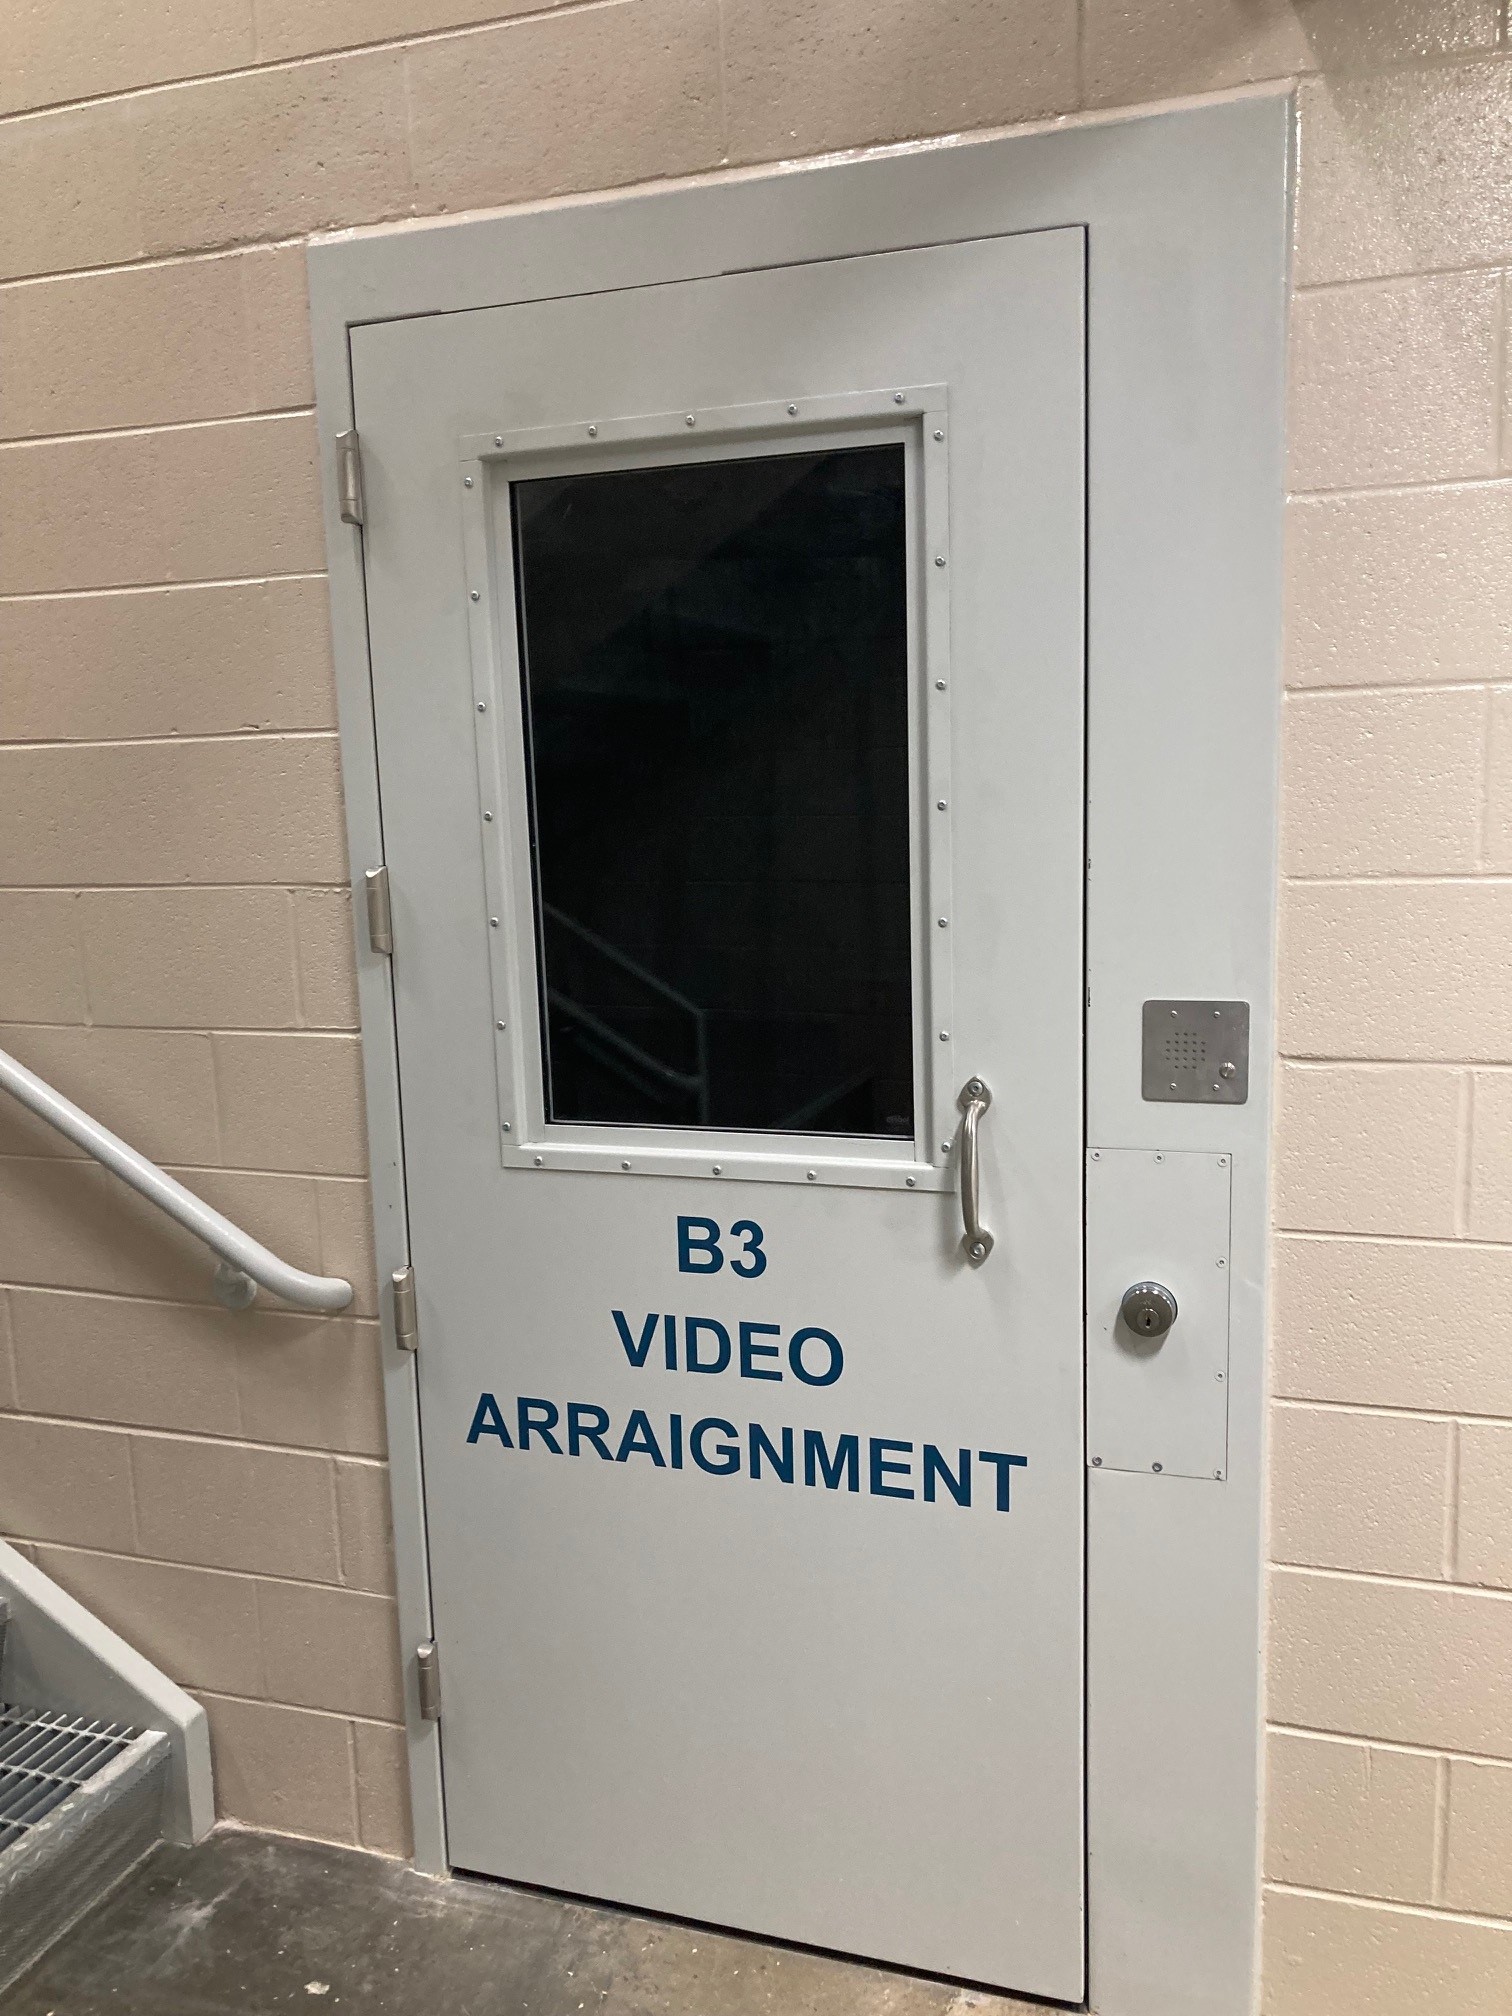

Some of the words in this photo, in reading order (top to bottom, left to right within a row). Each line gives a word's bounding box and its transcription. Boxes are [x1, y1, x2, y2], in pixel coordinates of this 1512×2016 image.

[677, 1215, 768, 1279] B3
[612, 1310, 844, 1387] VIDEO
[466, 1393, 1028, 1513] ARRAIGNMENT
